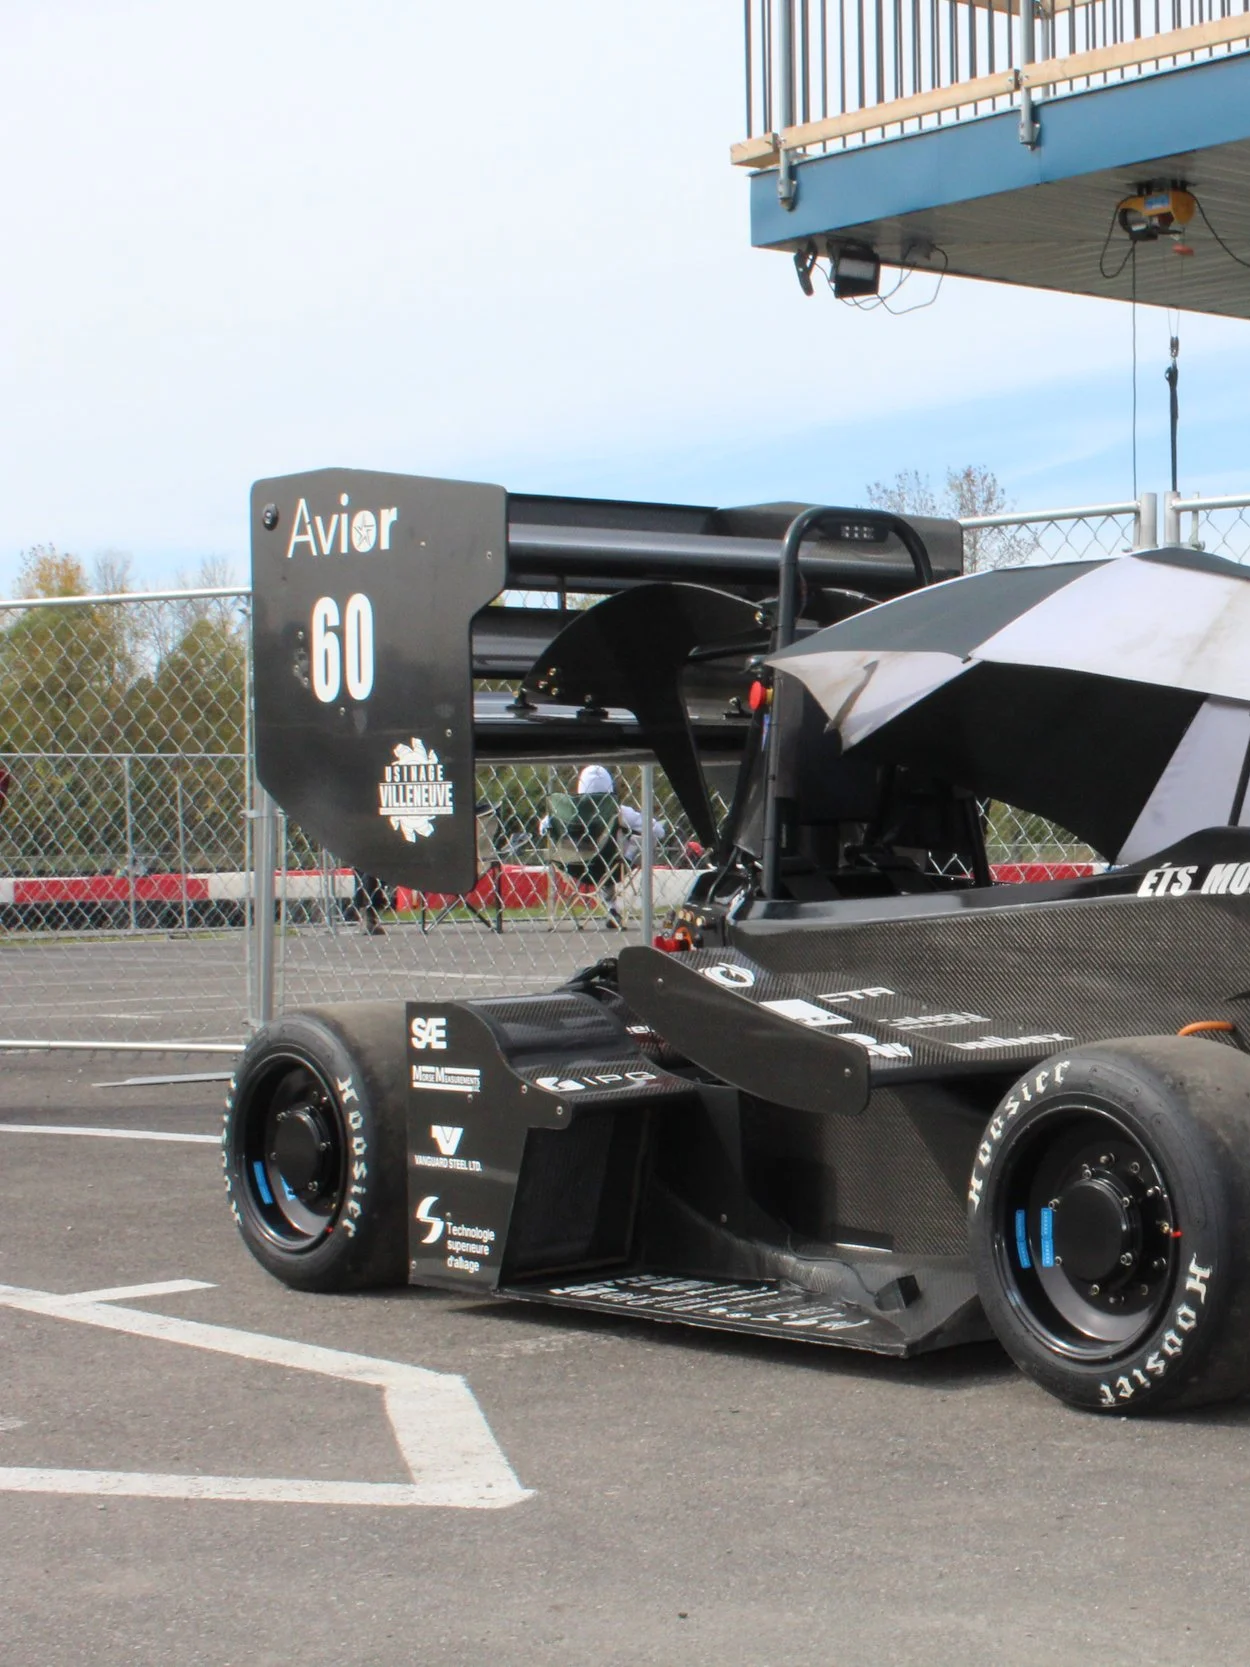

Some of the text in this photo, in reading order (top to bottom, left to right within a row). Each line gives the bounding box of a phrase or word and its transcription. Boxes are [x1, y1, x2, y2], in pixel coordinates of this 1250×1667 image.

[286, 492, 398, 559] Avior
[311, 592, 375, 703] 60
[385, 764, 444, 782] USINAGE
[379, 784, 454, 807] VILLENEUVE
[1137, 862, 1199, 898] ÉTS
[411, 1017, 448, 1050] SAE
[969, 1060, 1071, 1211] Hoosier
[336, 1076, 368, 1239] Hoosier
[414, 1154, 483, 1172] VANGUARD STEEL LTD.
[445, 1222, 495, 1243] Technologie
[1099, 1252, 1213, 1405] Hoosier
